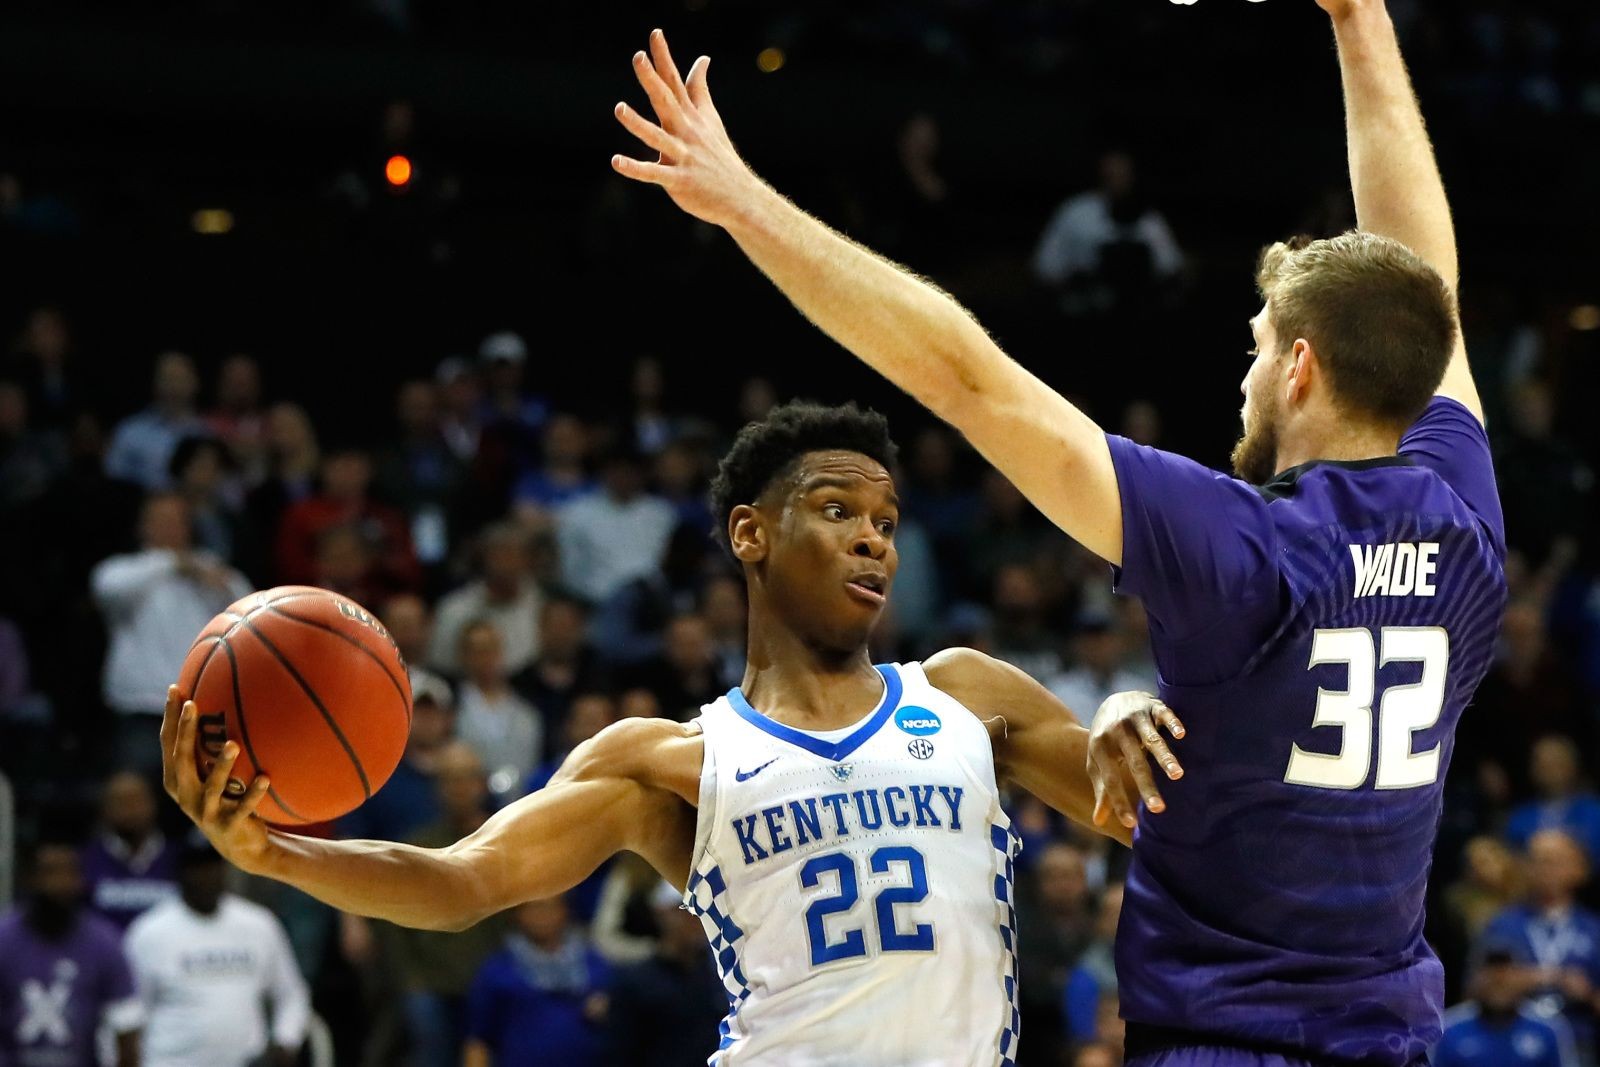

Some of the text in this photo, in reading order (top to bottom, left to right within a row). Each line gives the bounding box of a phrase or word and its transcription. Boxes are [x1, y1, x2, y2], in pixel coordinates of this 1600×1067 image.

[1349, 542, 1439, 598] WADE
[902, 719, 940, 728] NCAA
[1283, 626, 1449, 790] 32
[908, 739, 933, 759] SEC
[731, 785, 963, 864] KENTUCKY
[800, 846, 935, 966] 22
